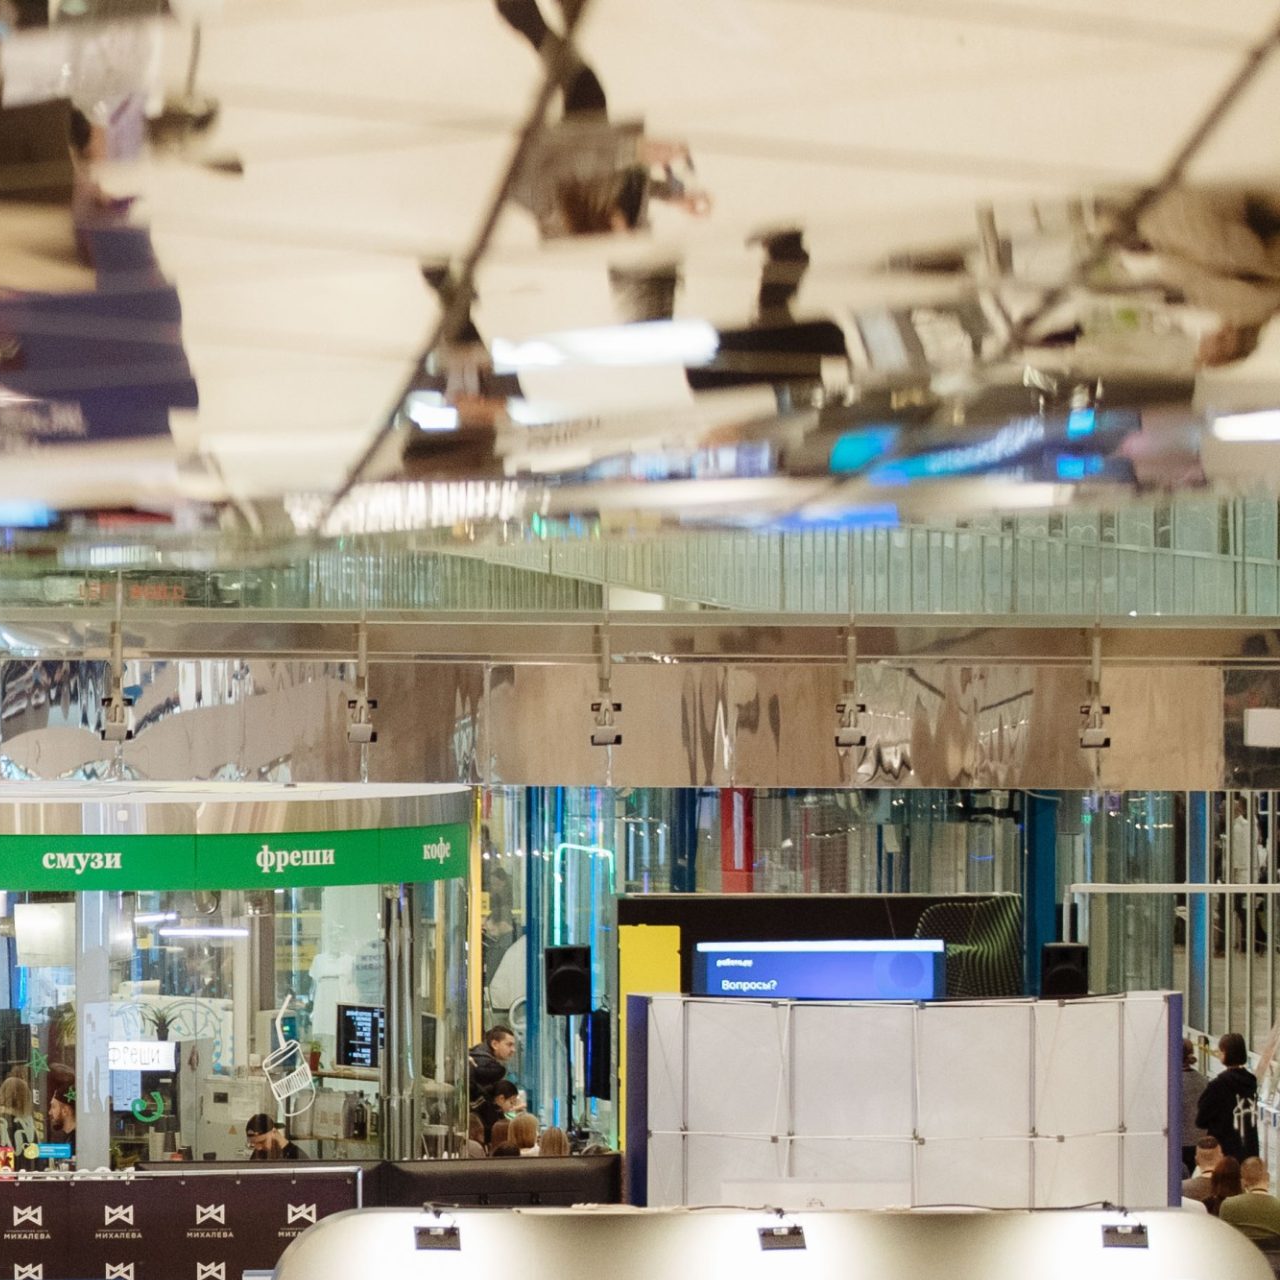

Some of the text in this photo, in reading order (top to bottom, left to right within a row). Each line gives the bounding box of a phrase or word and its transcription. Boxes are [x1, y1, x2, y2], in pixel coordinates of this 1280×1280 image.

[42, 851, 122, 876] смузи
[255, 845, 335, 873] фреши
[422, 837, 451, 865] кофе
[721, 979, 777, 992] Вопросы?
